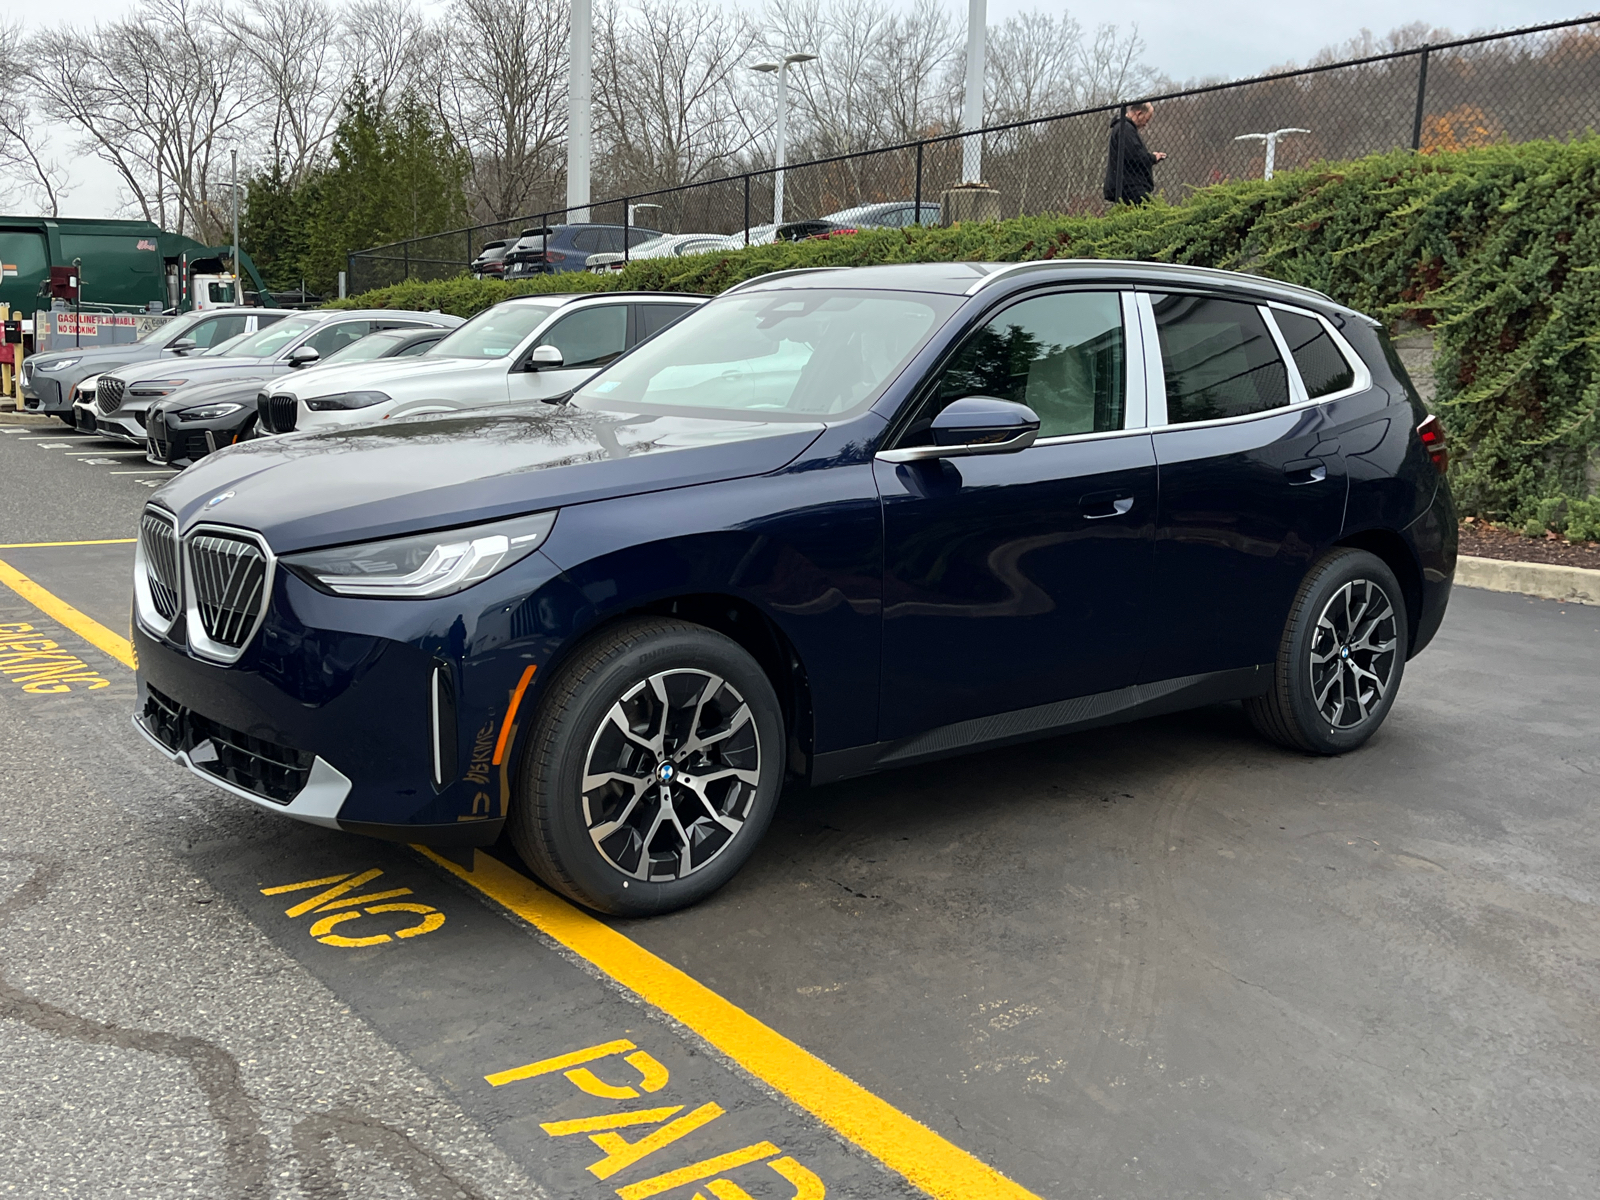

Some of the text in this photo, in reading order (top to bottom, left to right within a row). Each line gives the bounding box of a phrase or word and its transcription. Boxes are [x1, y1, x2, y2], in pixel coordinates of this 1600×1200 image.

[58, 314, 136, 326] GASOLINE FLAMMABLE
[58, 325, 68, 333] NO
[69, 325, 97, 335] SMOKING
[259, 867, 446, 947] NO
